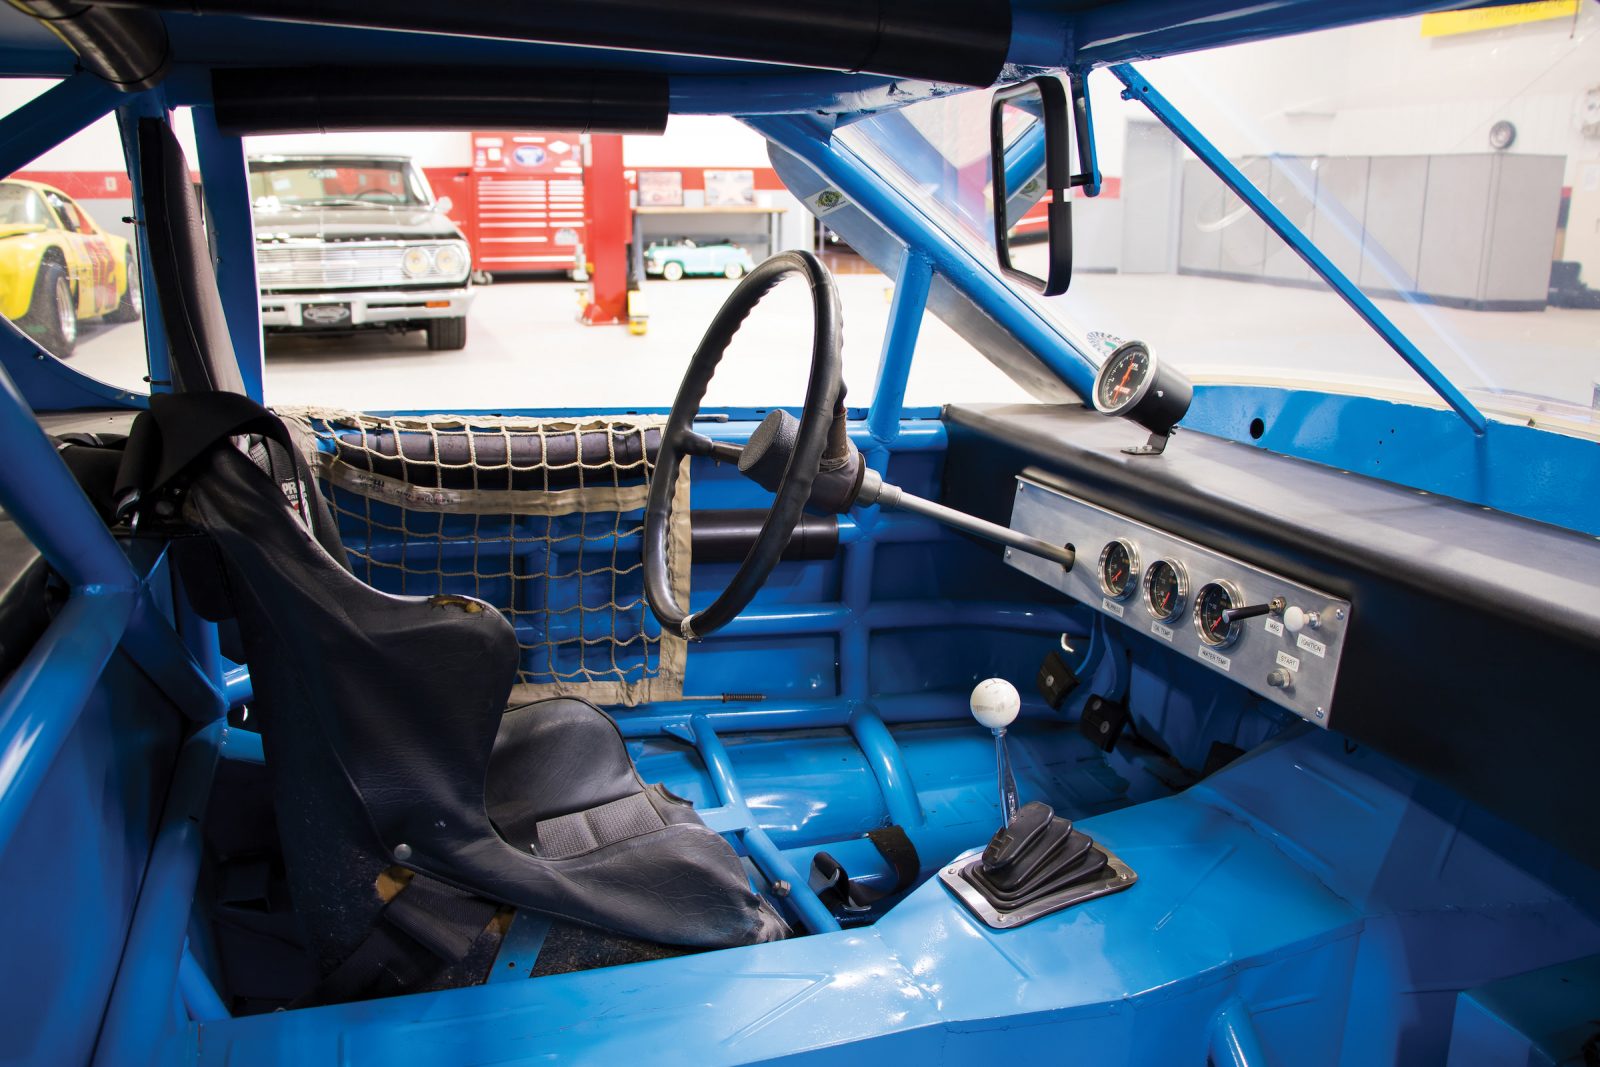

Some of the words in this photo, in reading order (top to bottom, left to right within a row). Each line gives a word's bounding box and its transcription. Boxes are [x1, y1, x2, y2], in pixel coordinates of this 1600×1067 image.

[1269, 622, 1280, 632] MAG
[1301, 638, 1323, 653] IGNITION
[1280, 655, 1298, 667] START
